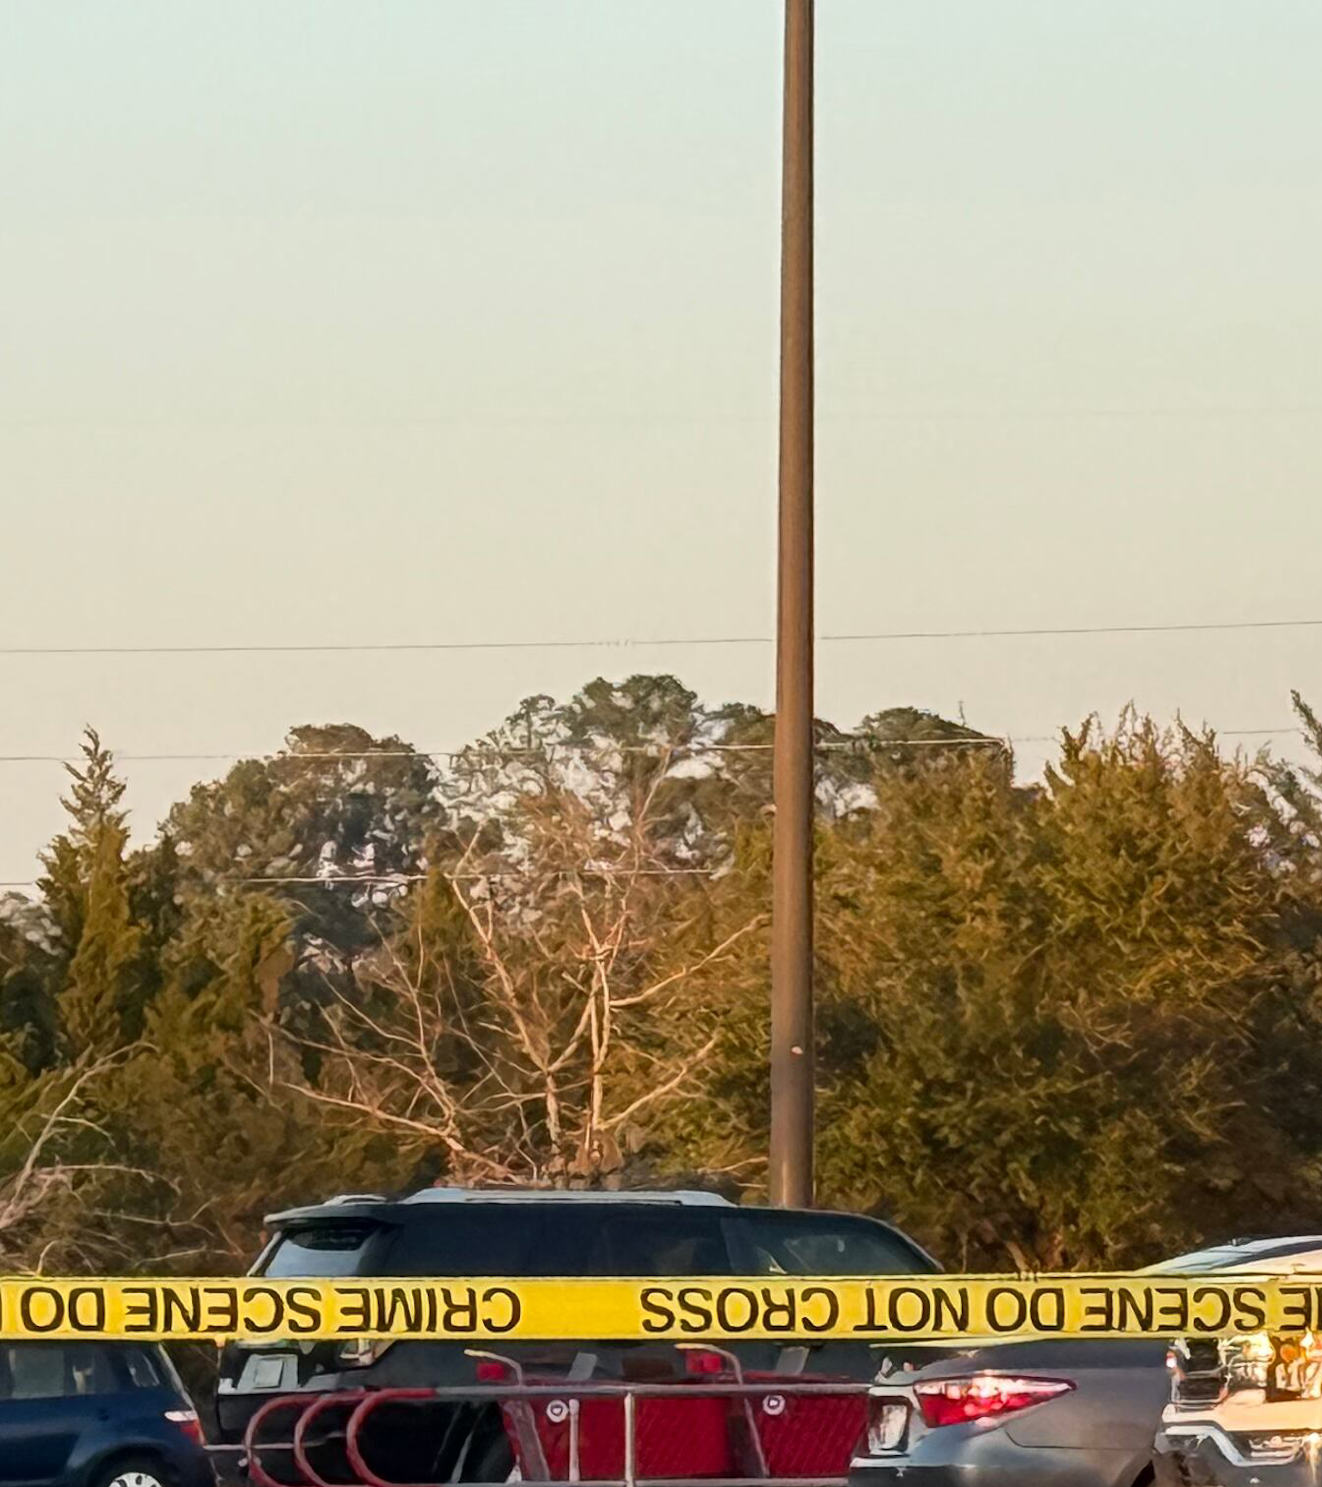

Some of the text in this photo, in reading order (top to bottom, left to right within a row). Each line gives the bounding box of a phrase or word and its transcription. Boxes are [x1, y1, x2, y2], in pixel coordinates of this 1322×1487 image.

[20, 1286, 521, 1333] CRIME SCENE DO
[640, 1287, 839, 1333] CROSS
[853, 1287, 969, 1332] NOT
[985, 1287, 1065, 1332] DO
[1080, 1287, 1266, 1333] SCENE
